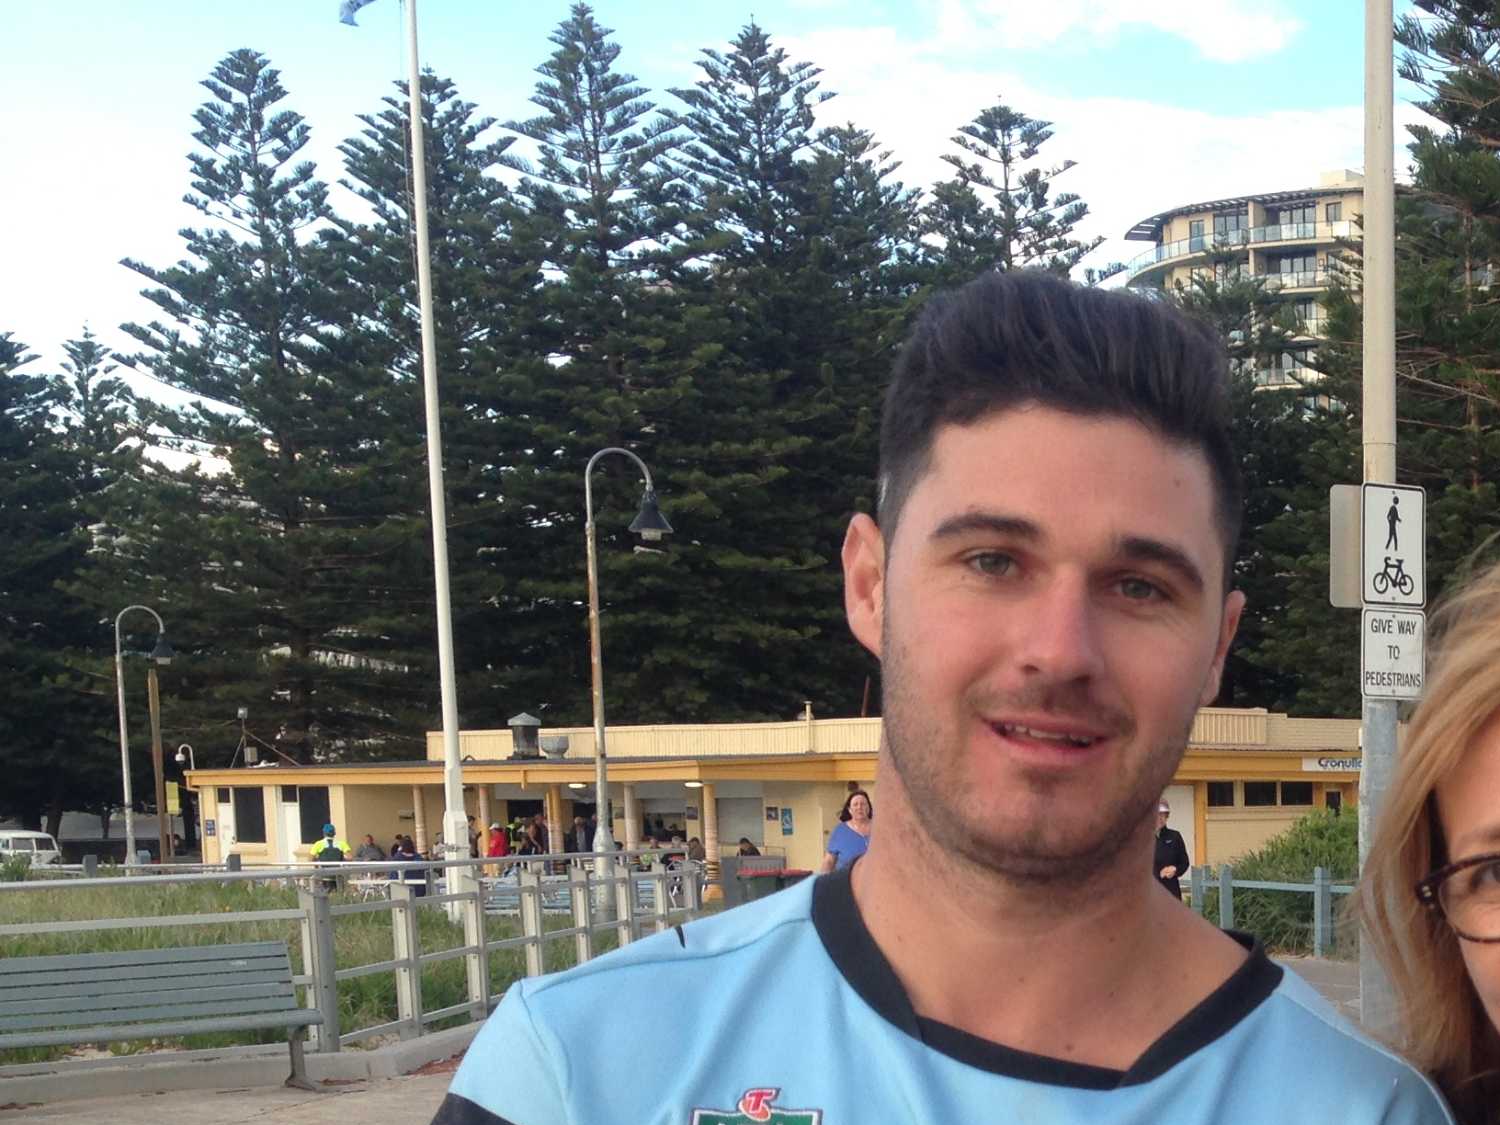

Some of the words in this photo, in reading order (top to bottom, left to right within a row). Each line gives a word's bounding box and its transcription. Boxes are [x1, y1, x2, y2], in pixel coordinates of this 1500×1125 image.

[1370, 618, 1393, 634] GIVE
[1398, 620, 1417, 635] WAY
[1387, 645, 1401, 660] TO
[1365, 671, 1422, 688] PEDESTRIANS
